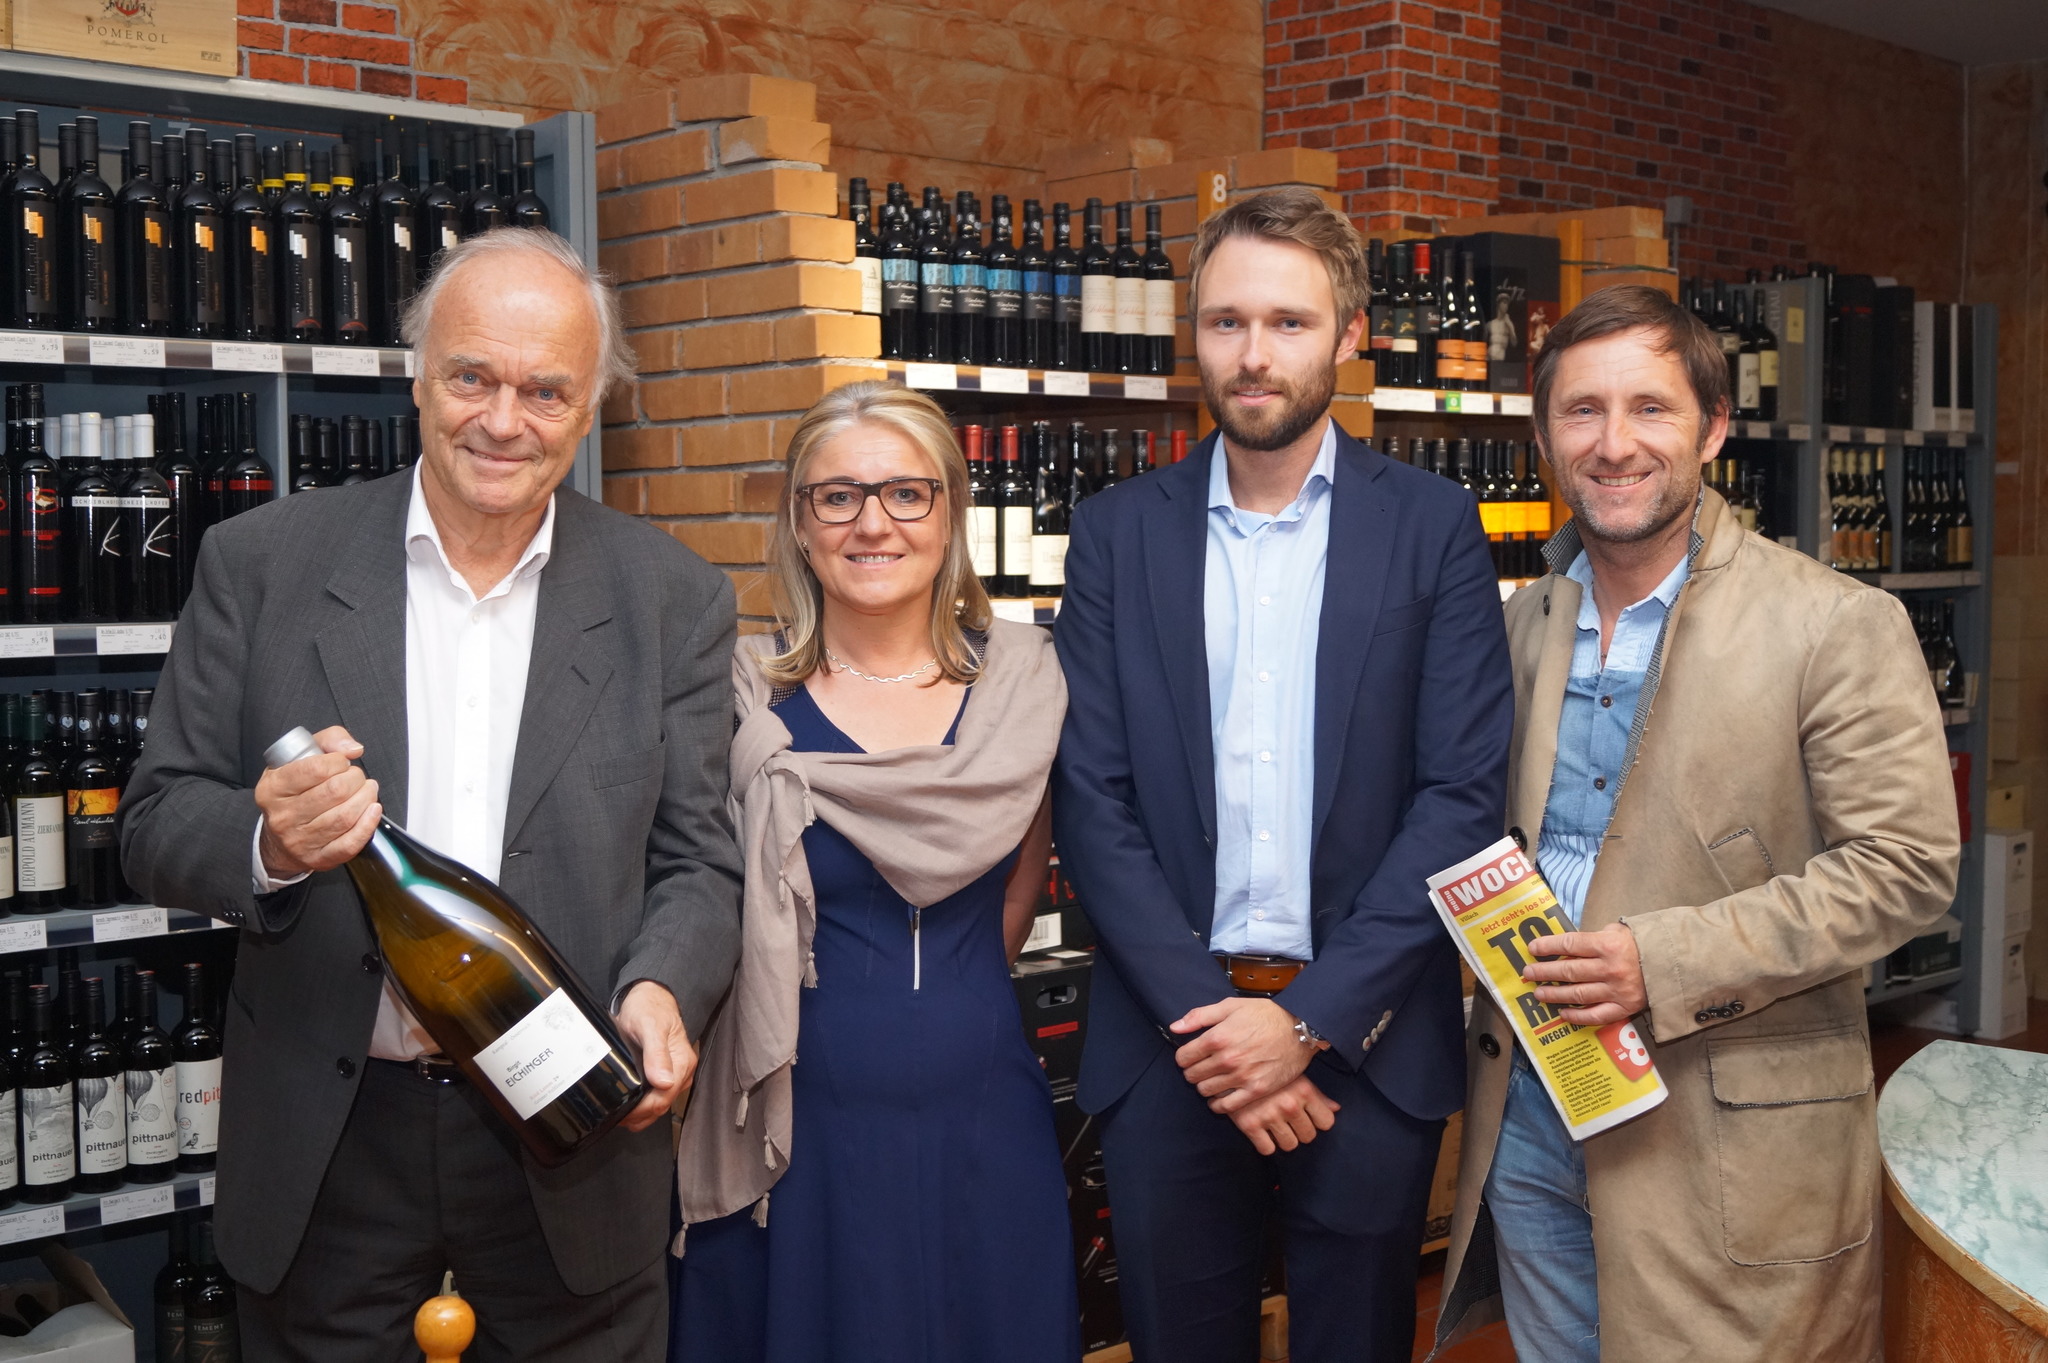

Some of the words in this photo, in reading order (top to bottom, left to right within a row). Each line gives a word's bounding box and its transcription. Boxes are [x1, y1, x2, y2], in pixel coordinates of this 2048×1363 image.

[87, 25, 168, 44] POMEROL
[1212, 173, 1227, 203] 8
[20, 801, 35, 842] AUMANN
[21, 846, 36, 887] LEOPOLD
[1444, 890, 1460, 912] meine
[1460, 911, 1479, 923] Villach
[1480, 922, 1501, 935] Jetzt
[1500, 910, 1526, 926] geht's
[1525, 902, 1539, 912] los
[1538, 1025, 1571, 1046] WEGEN
[505, 1047, 554, 1088] EICHINGER
[506, 1059, 522, 1073] Birgit
[193, 1323, 224, 1331] TEMENT
